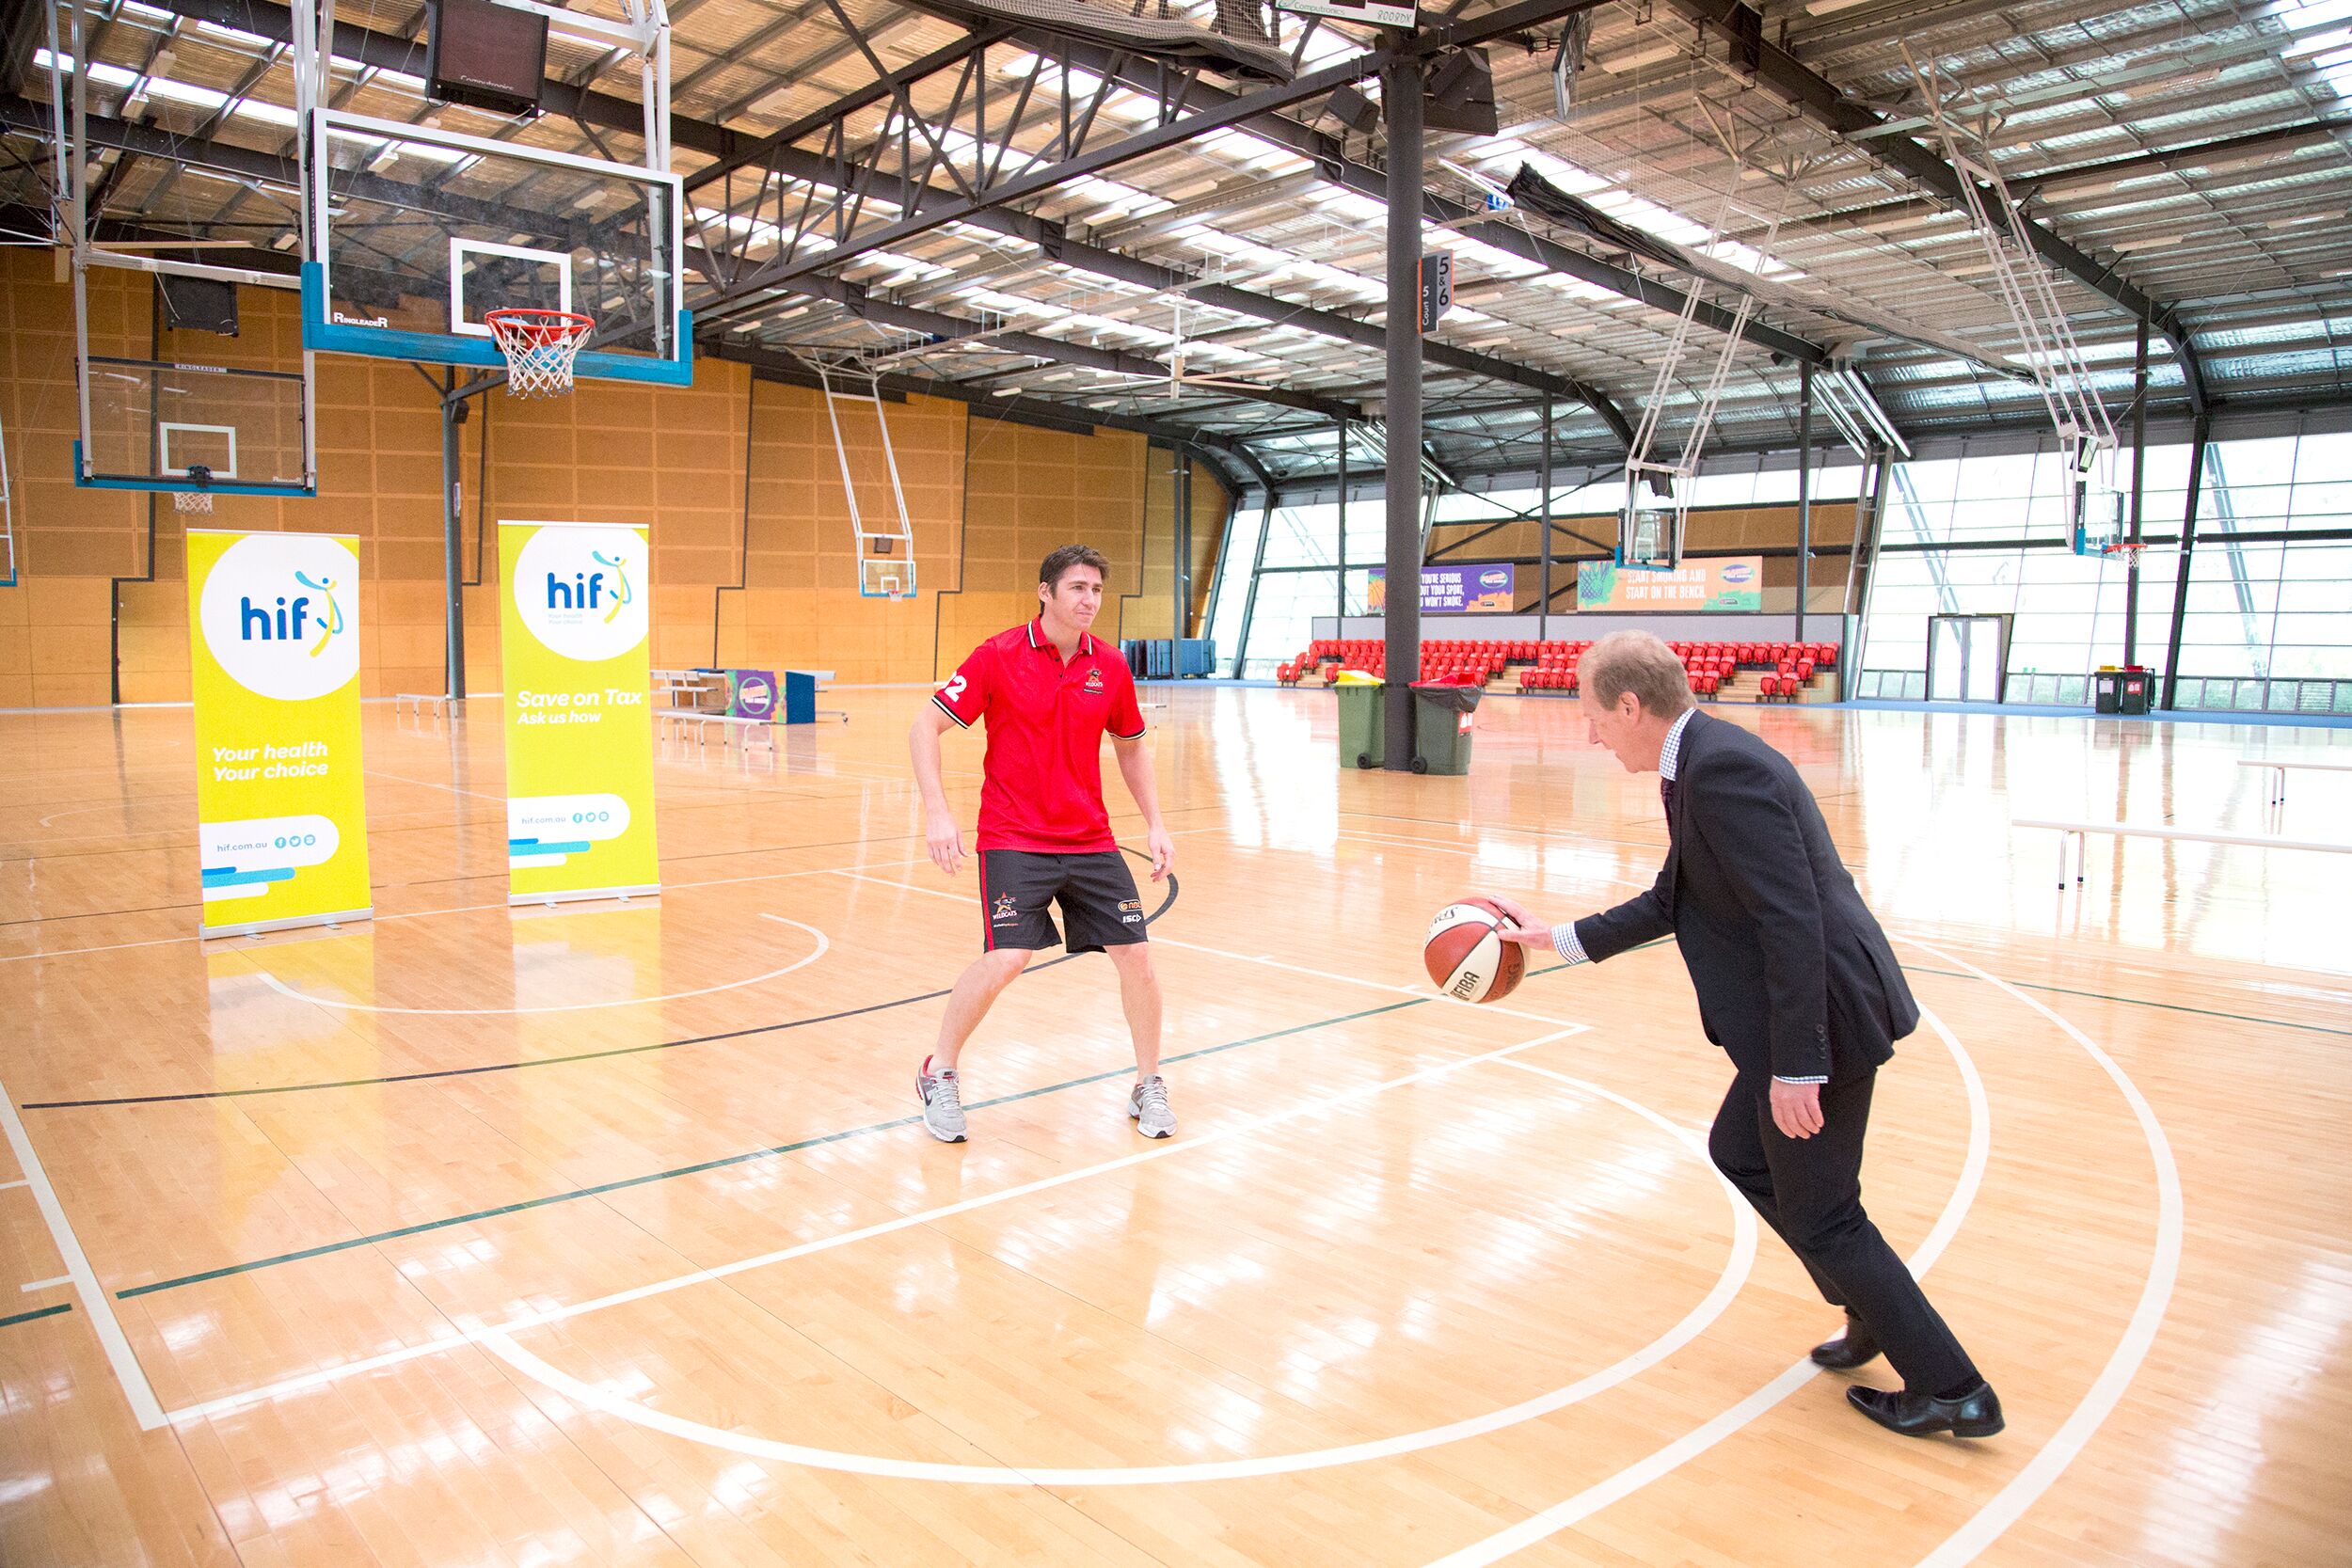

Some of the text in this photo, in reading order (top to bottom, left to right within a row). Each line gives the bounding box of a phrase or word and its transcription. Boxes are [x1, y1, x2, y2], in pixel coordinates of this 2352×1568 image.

[1294, 2, 1345, 15] Computronics
[1438, 256, 1449, 275] 5
[1422, 286, 1429, 297] 5
[1438, 288, 1449, 307] 6
[1440, 573, 1461, 583] SERIOUS
[1689, 569, 1707, 582] AND
[548, 572, 604, 609] hif
[1431, 585, 1446, 595] YOUR
[1626, 586, 1649, 599] START
[1651, 586, 1661, 599] ON
[1663, 586, 1677, 599] THE
[1424, 596, 1442, 608] WON'T
[241, 596, 310, 641] hif
[516, 688, 643, 707] Save on Tax
[517, 710, 602, 724] Ask us how
[213, 741, 328, 762] Your health
[214, 760, 329, 782] Your choice
[217, 842, 267, 852] hif.com.au
[993, 910, 1017, 921] WILDCATS
[1454, 971, 1480, 998] FIBA
